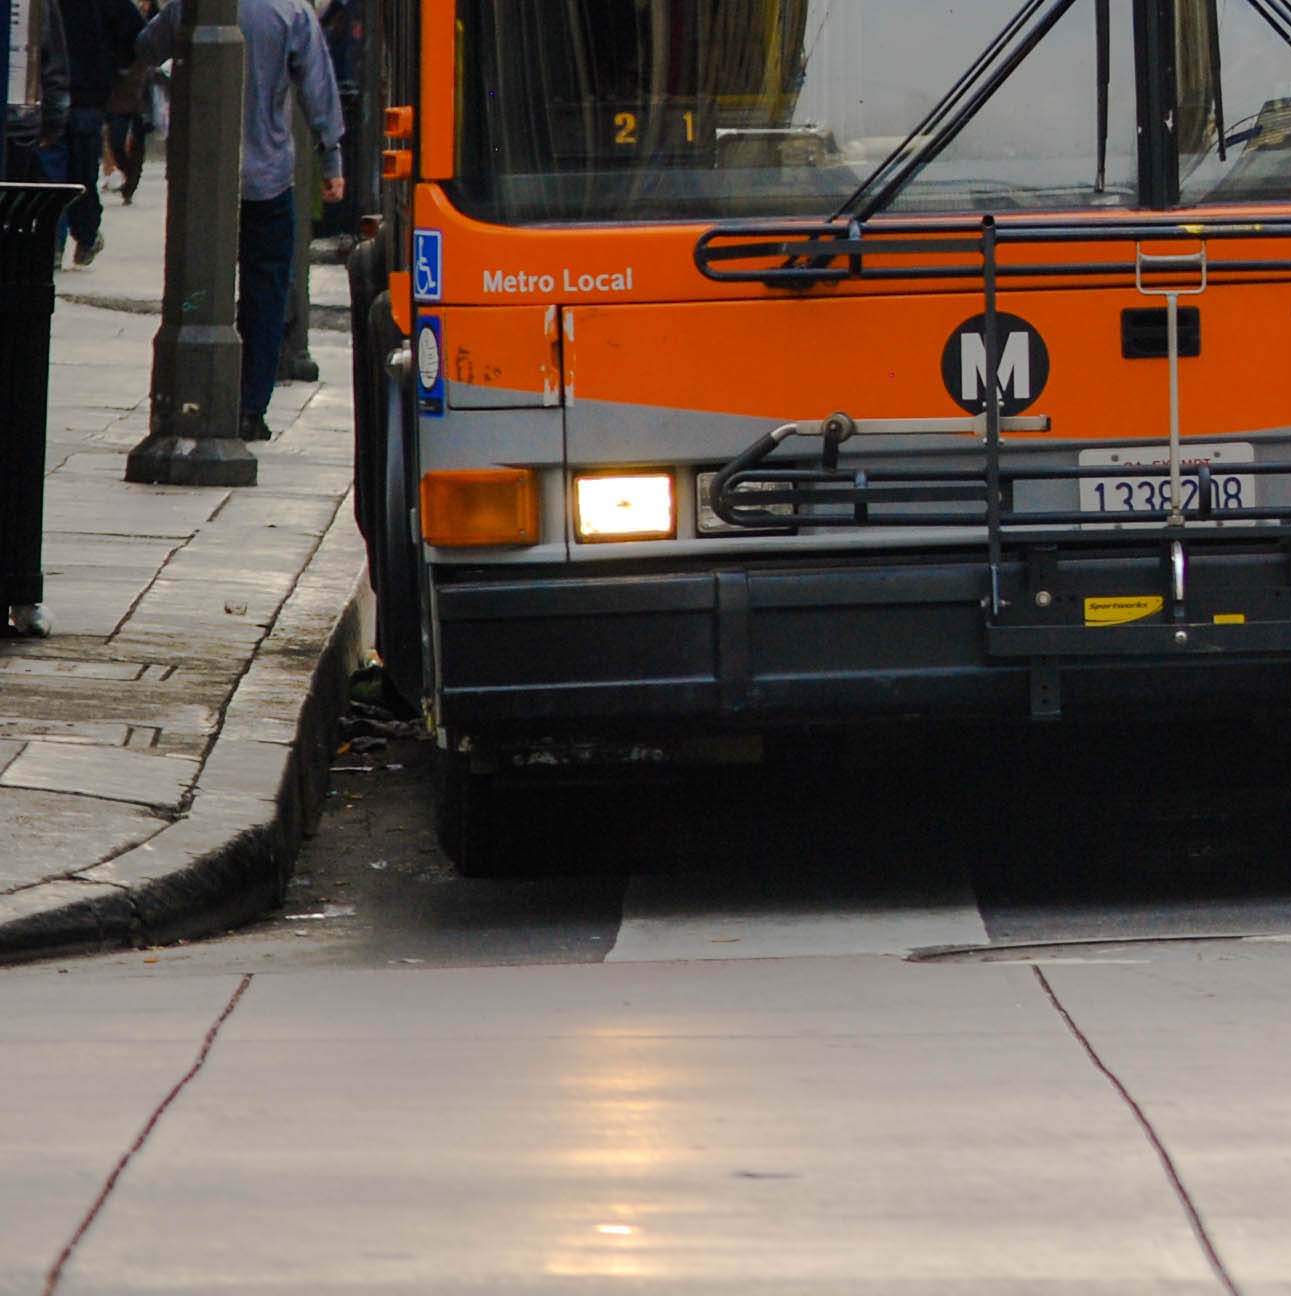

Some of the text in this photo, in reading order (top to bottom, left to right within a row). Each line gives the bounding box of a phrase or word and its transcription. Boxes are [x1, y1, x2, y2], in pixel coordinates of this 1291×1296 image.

[483, 266, 633, 293] Metro Local
[960, 330, 1031, 401] M
[1088, 601, 1148, 612] Sportworks
